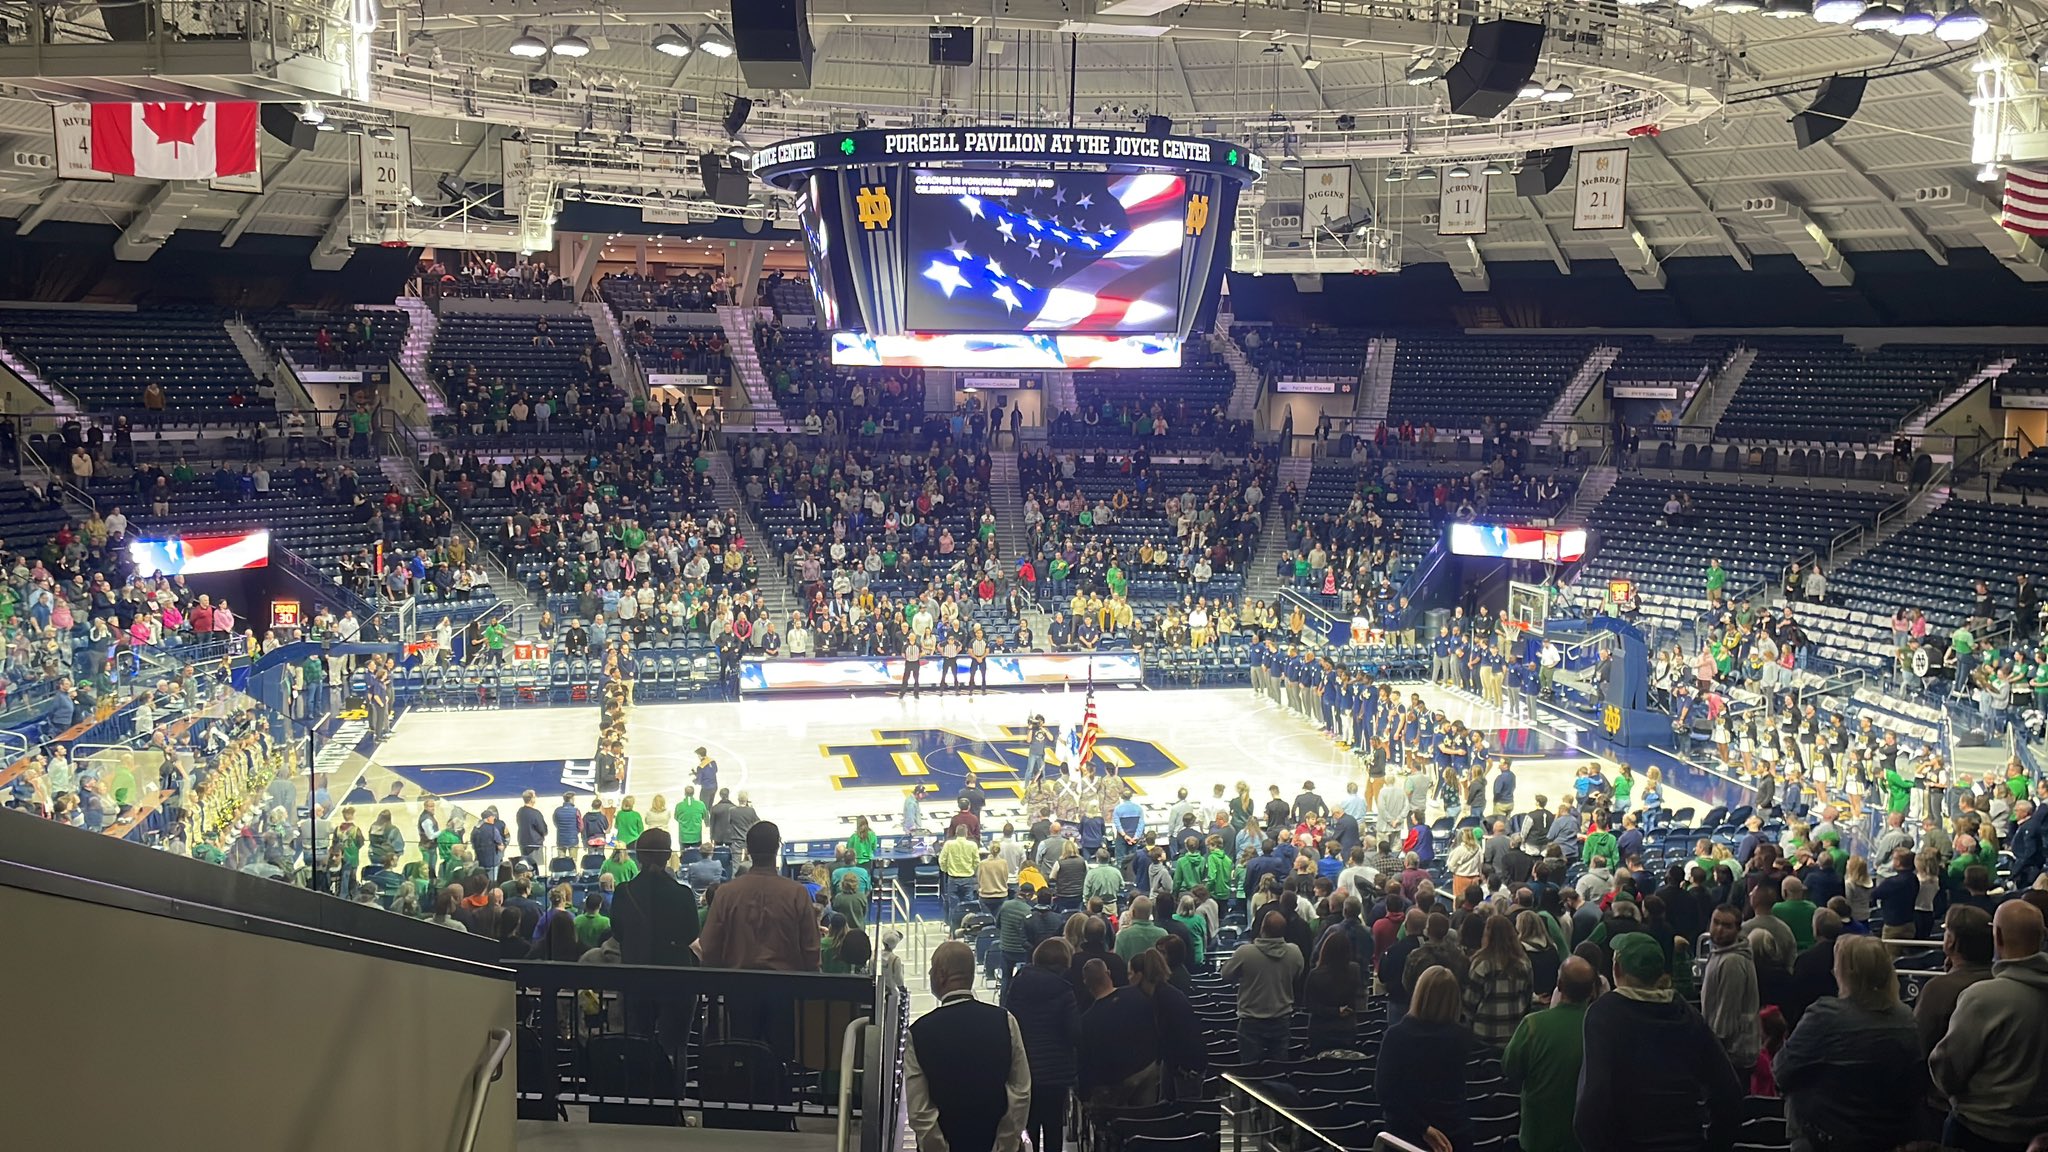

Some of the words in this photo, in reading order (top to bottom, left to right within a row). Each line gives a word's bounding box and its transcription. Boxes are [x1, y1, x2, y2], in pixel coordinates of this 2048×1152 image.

[79, 136, 88, 154] 4
[777, 141, 816, 163] CENTER
[885, 133, 960, 154] PURCELL
[964, 132, 1047, 152] PAVILION
[1050, 133, 1075, 154] AT
[1077, 134, 1110, 155] THE
[1113, 136, 1160, 158] JOYCE
[1162, 138, 1211, 163] CENTER
[377, 166, 397, 184] 20
[1581, 176, 1622, 188] McBRIDE
[1308, 190, 1344, 200] DIGGINS
[1590, 191, 1608, 208] 21
[1321, 204, 1329, 219] 4
[1455, 199, 1470, 214] 11
[279, 613, 293, 624] 30
